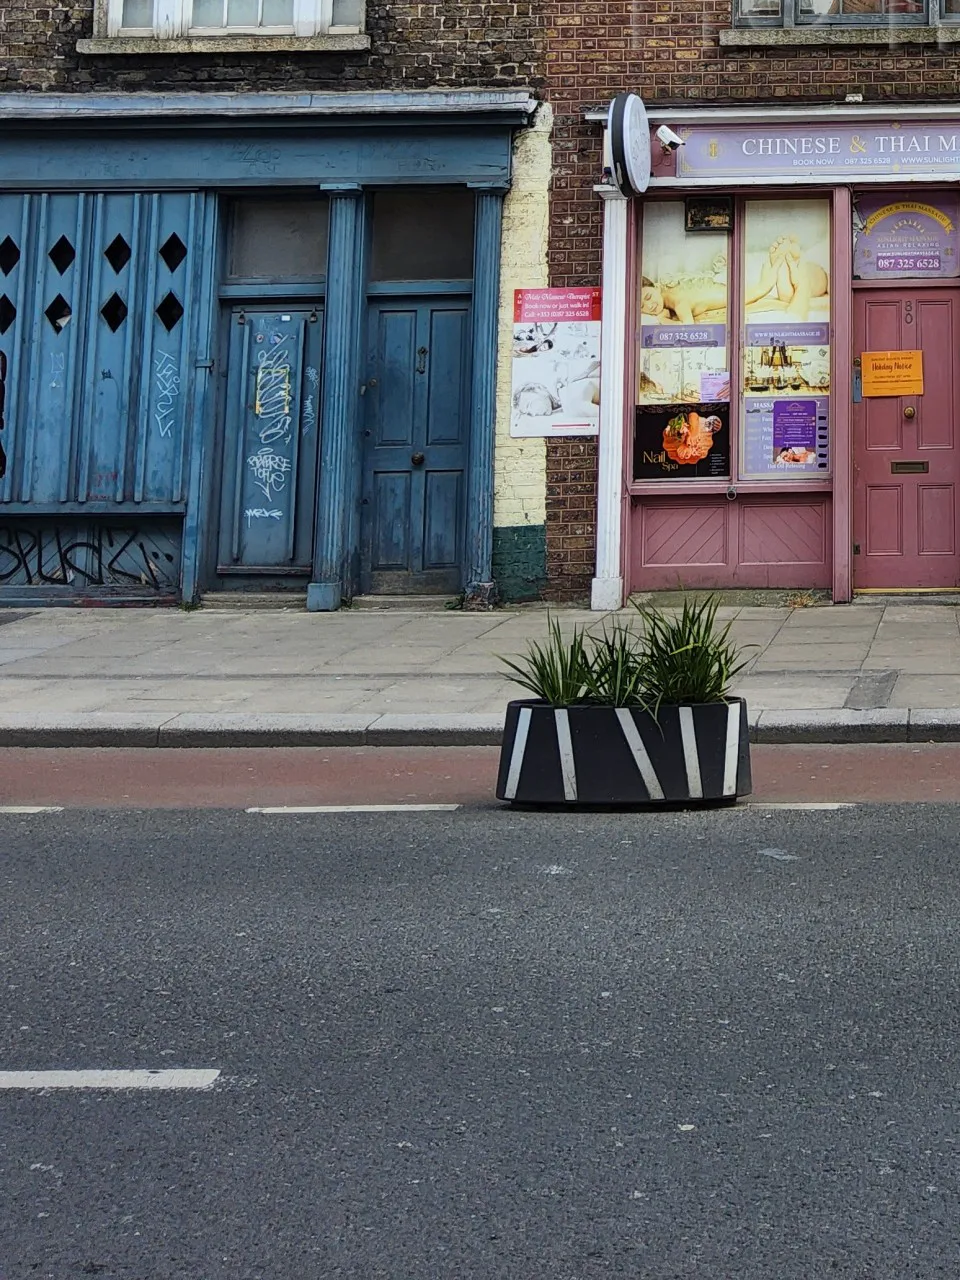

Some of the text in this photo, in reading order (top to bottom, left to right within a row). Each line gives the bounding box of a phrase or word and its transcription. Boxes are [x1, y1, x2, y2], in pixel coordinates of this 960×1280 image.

[742, 137, 841, 156] CHINESE
[850, 136, 866, 153] &
[875, 136, 930, 153] THAI
[869, 206, 894, 224] CHINESE
[878, 258, 940, 269] 087 325 6528
[558, 302, 569, 310] just
[905, 300, 913, 324] 80
[659, 332, 708, 341] 087 325 6528
[872, 361, 912, 373] Holiday Notice
[643, 450, 666, 464] Nail
[662, 461, 679, 472] Spa
